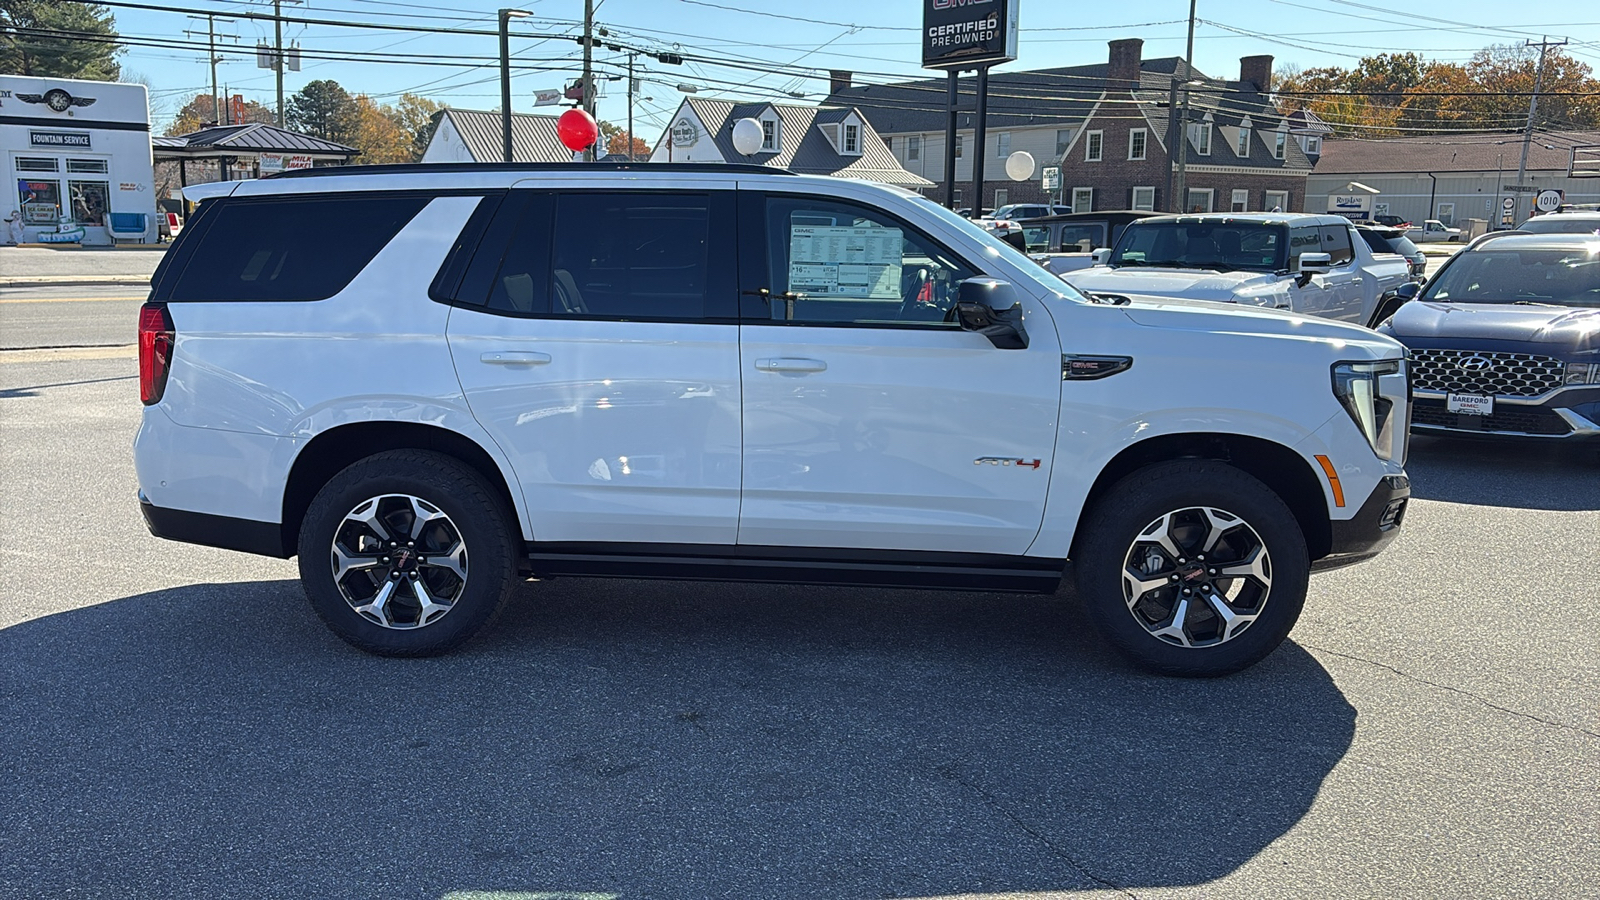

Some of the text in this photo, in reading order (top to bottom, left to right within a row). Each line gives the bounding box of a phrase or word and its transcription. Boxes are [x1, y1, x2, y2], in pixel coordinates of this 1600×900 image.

[929, 19, 997, 37] CERTIFIED
[931, 31, 993, 47] PRE-OWNED
[32, 134, 89, 145] FOUNTAIN SERVICE
[1540, 196, 1558, 205] 1010
[1072, 361, 1099, 369] GMC
[1452, 396, 1489, 404] BAREFORD
